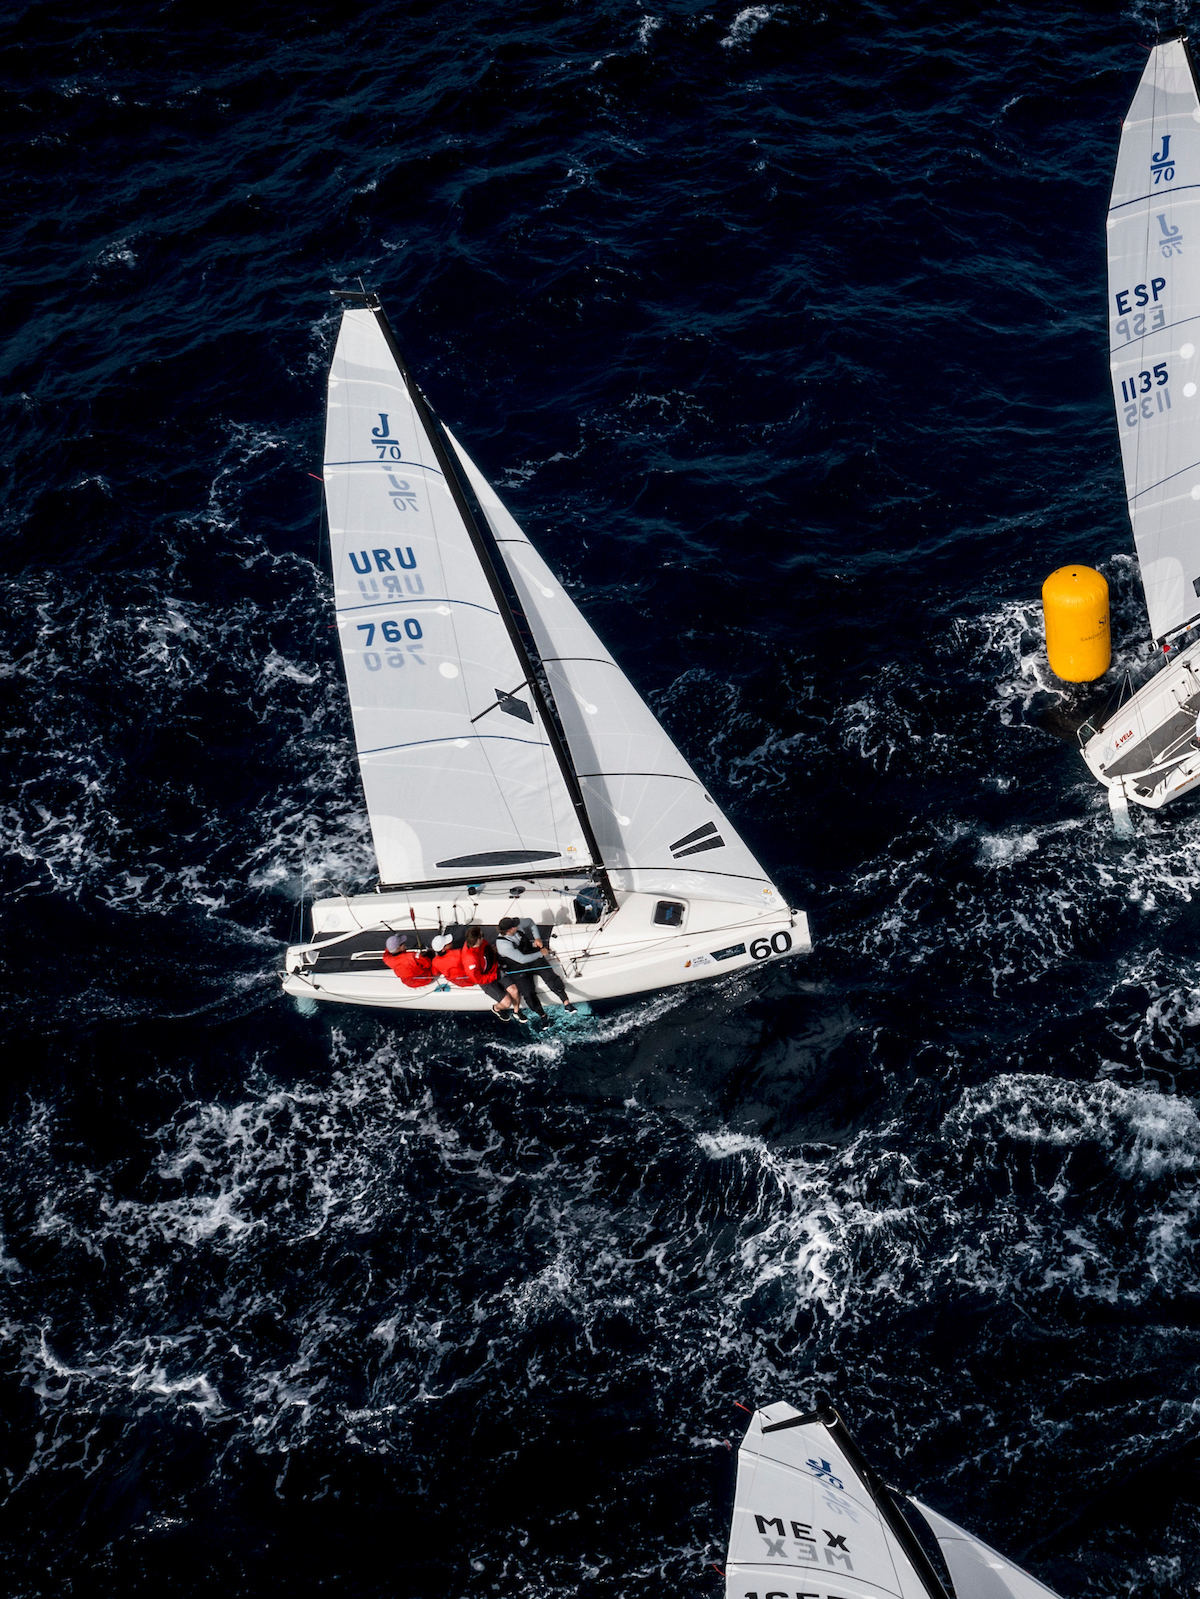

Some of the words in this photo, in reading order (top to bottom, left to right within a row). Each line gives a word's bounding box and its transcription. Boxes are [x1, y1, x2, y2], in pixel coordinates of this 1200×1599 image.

[1152, 135, 1171, 163] J
[1152, 167, 1174, 184] 70
[1115, 277, 1166, 316] ESP
[1122, 362, 1169, 403] 1135
[372, 413, 390, 438] J
[376, 445, 401, 460] 70
[349, 547, 417, 574] URU
[357, 618, 423, 646] 760
[1119, 730, 1133, 743] VELA
[750, 931, 792, 960] 60
[754, 1514, 850, 1553] MEX
